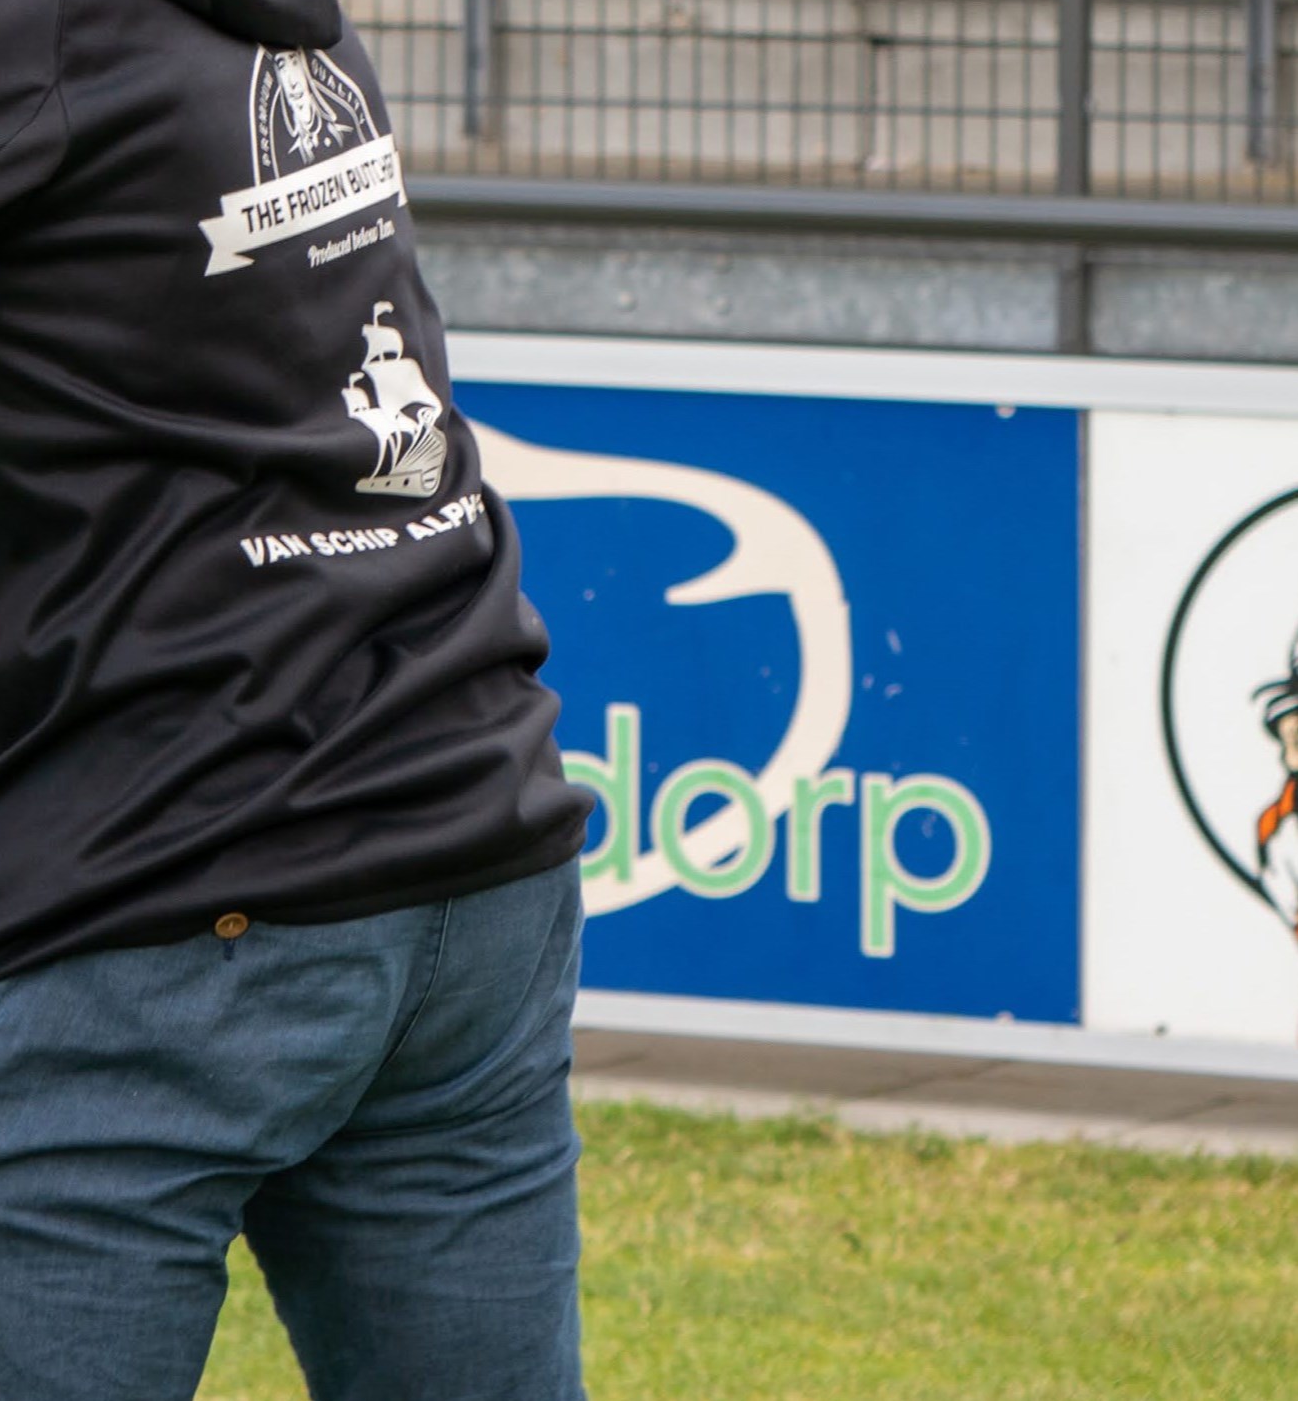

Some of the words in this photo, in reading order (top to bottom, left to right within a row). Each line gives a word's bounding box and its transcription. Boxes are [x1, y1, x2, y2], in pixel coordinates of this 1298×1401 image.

[311, 57, 365, 125] QUALITY
[241, 198, 285, 234] THE
[286, 170, 348, 218] FROZEN
[307, 229, 352, 268] Produced
[239, 534, 311, 567] VAN
[309, 527, 399, 556] SCHIP
